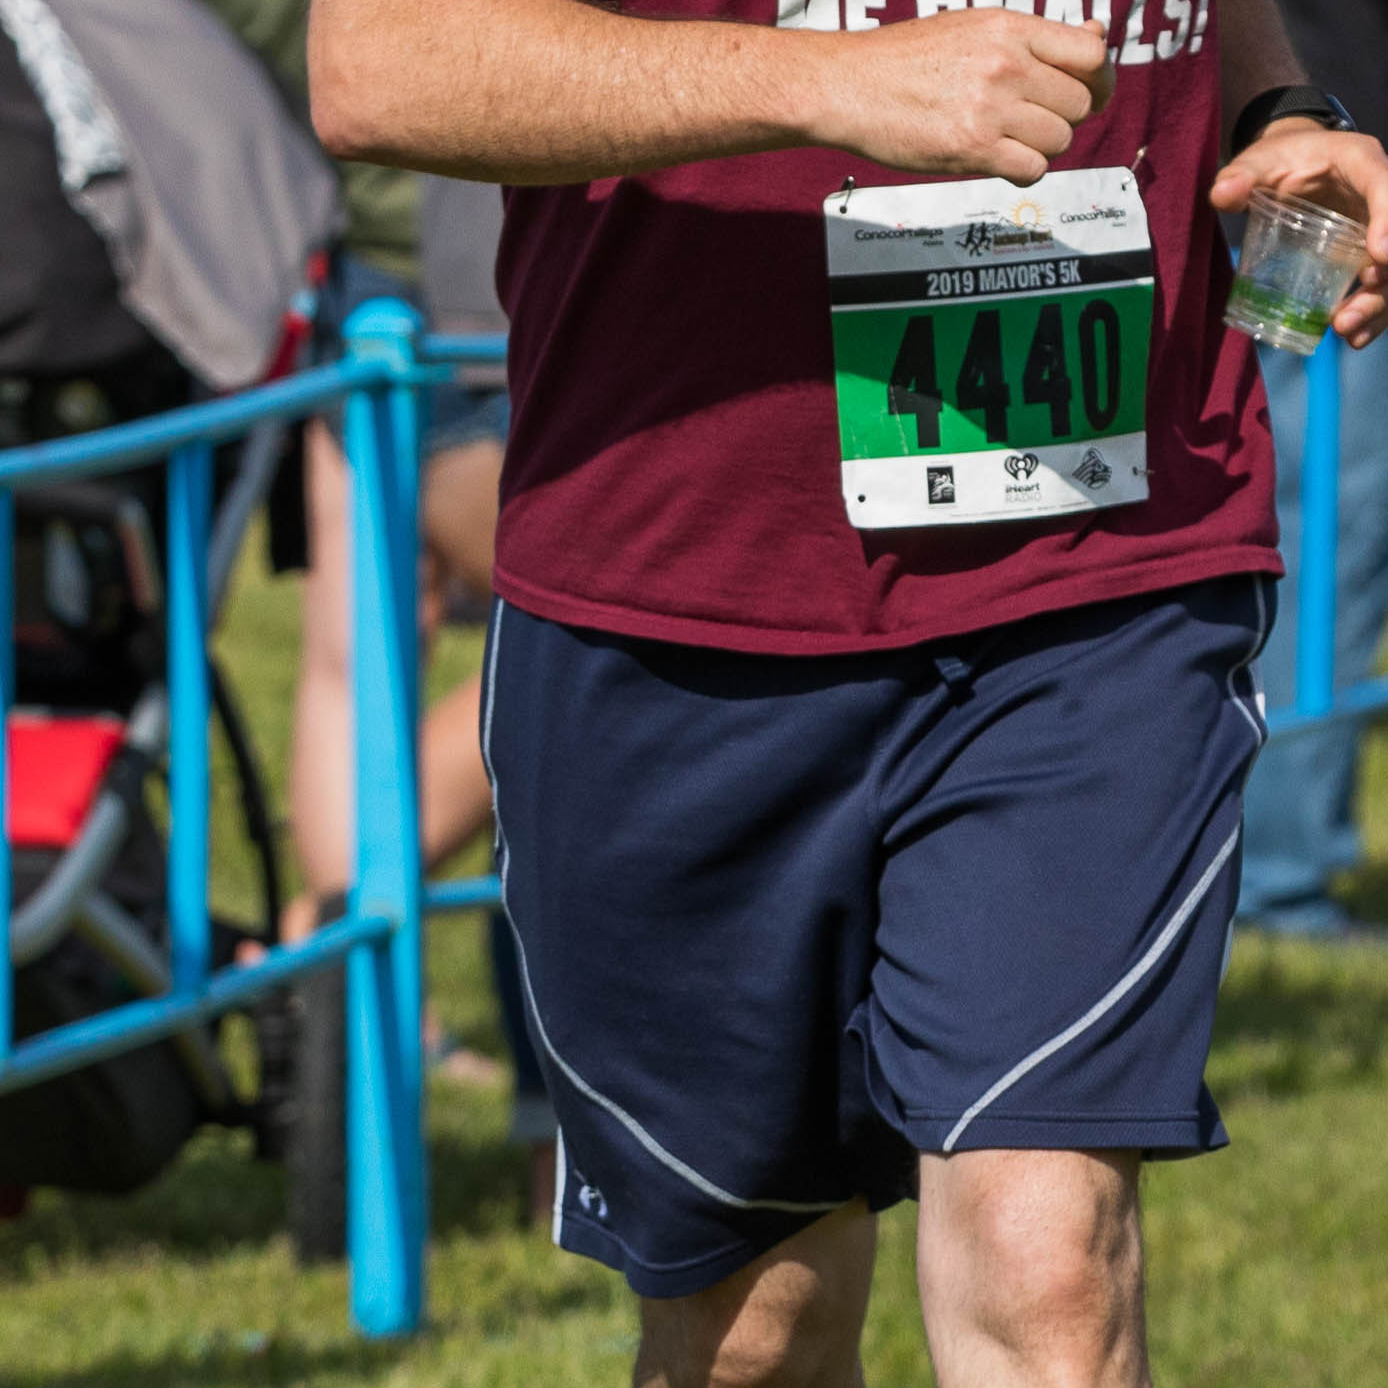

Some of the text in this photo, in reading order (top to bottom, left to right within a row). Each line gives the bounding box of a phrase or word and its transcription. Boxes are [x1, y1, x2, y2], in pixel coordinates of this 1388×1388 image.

[927, 260, 1082, 296] 2019 MAYOR'S 5K
[887, 298, 1121, 449] 4440
[1005, 483, 1040, 494] iHeart
